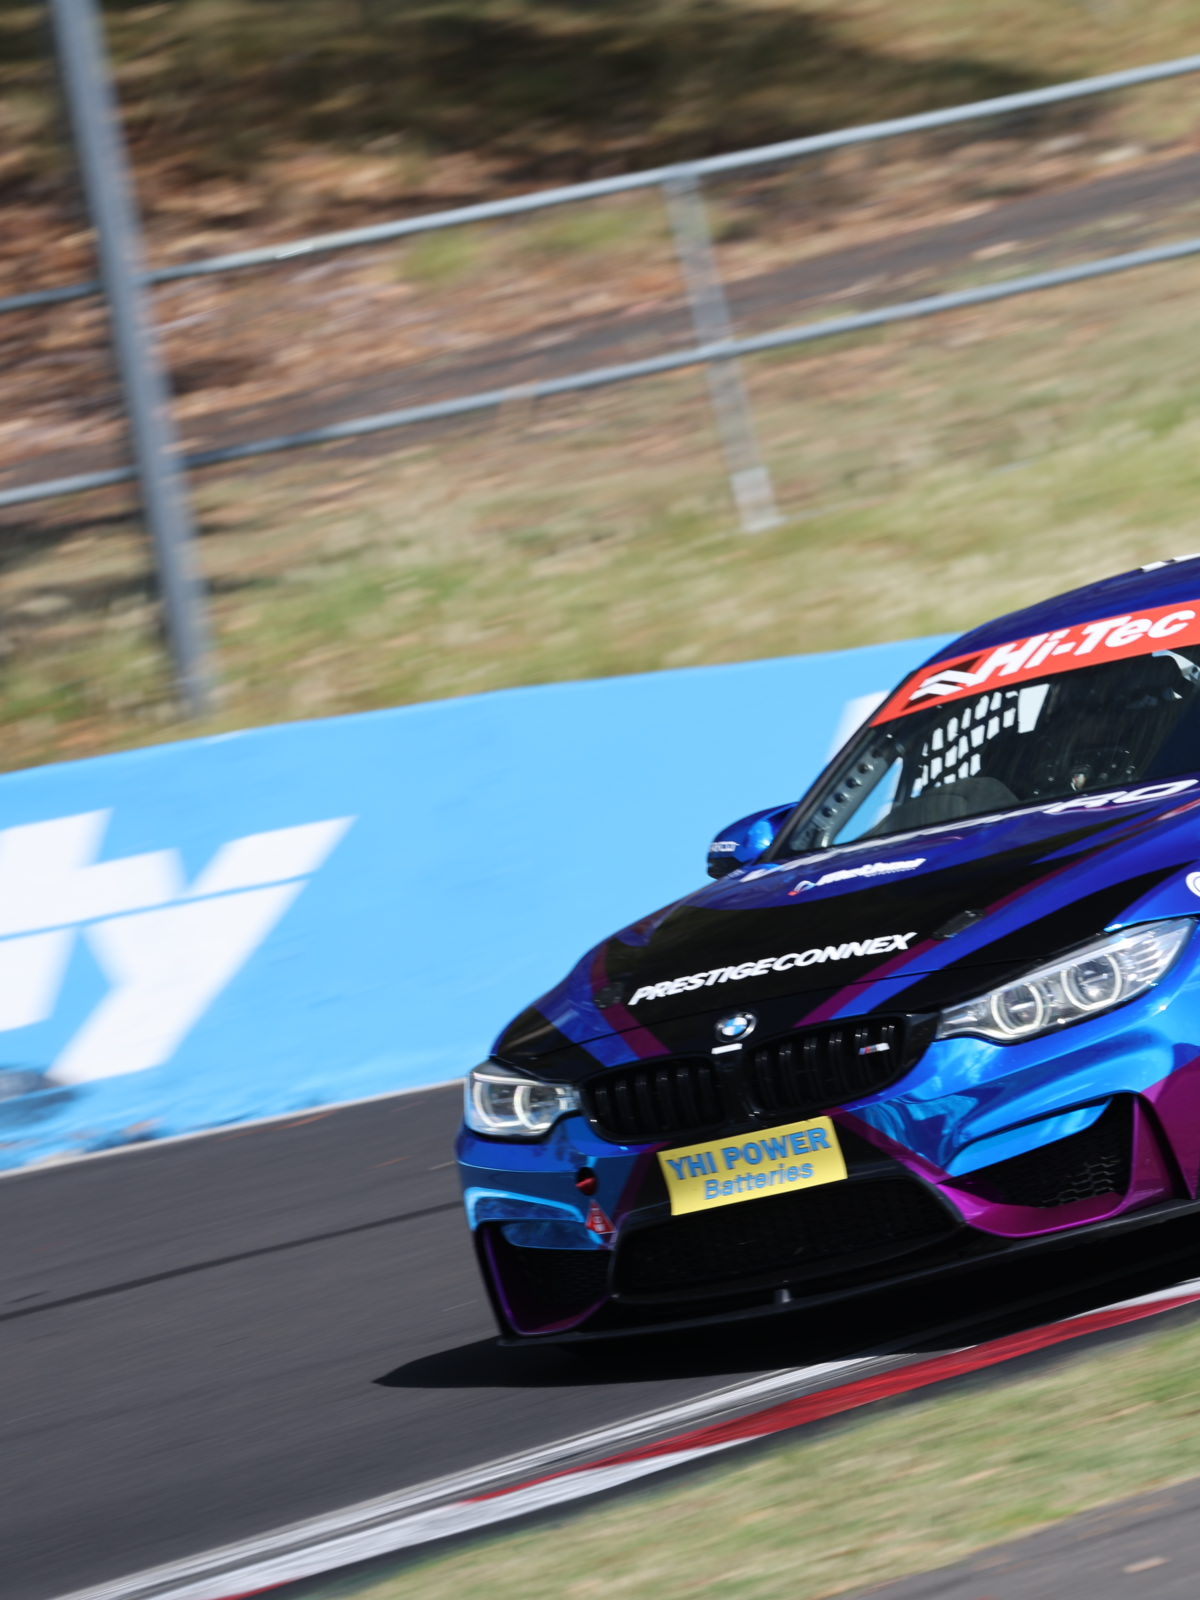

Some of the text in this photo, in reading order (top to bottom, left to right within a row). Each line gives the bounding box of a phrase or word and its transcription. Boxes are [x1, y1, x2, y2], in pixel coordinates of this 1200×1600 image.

[977, 609, 1196, 686] Hi-Tec
[665, 1127, 832, 1180] YHI POWER
[704, 1162, 815, 1200] Batteries
